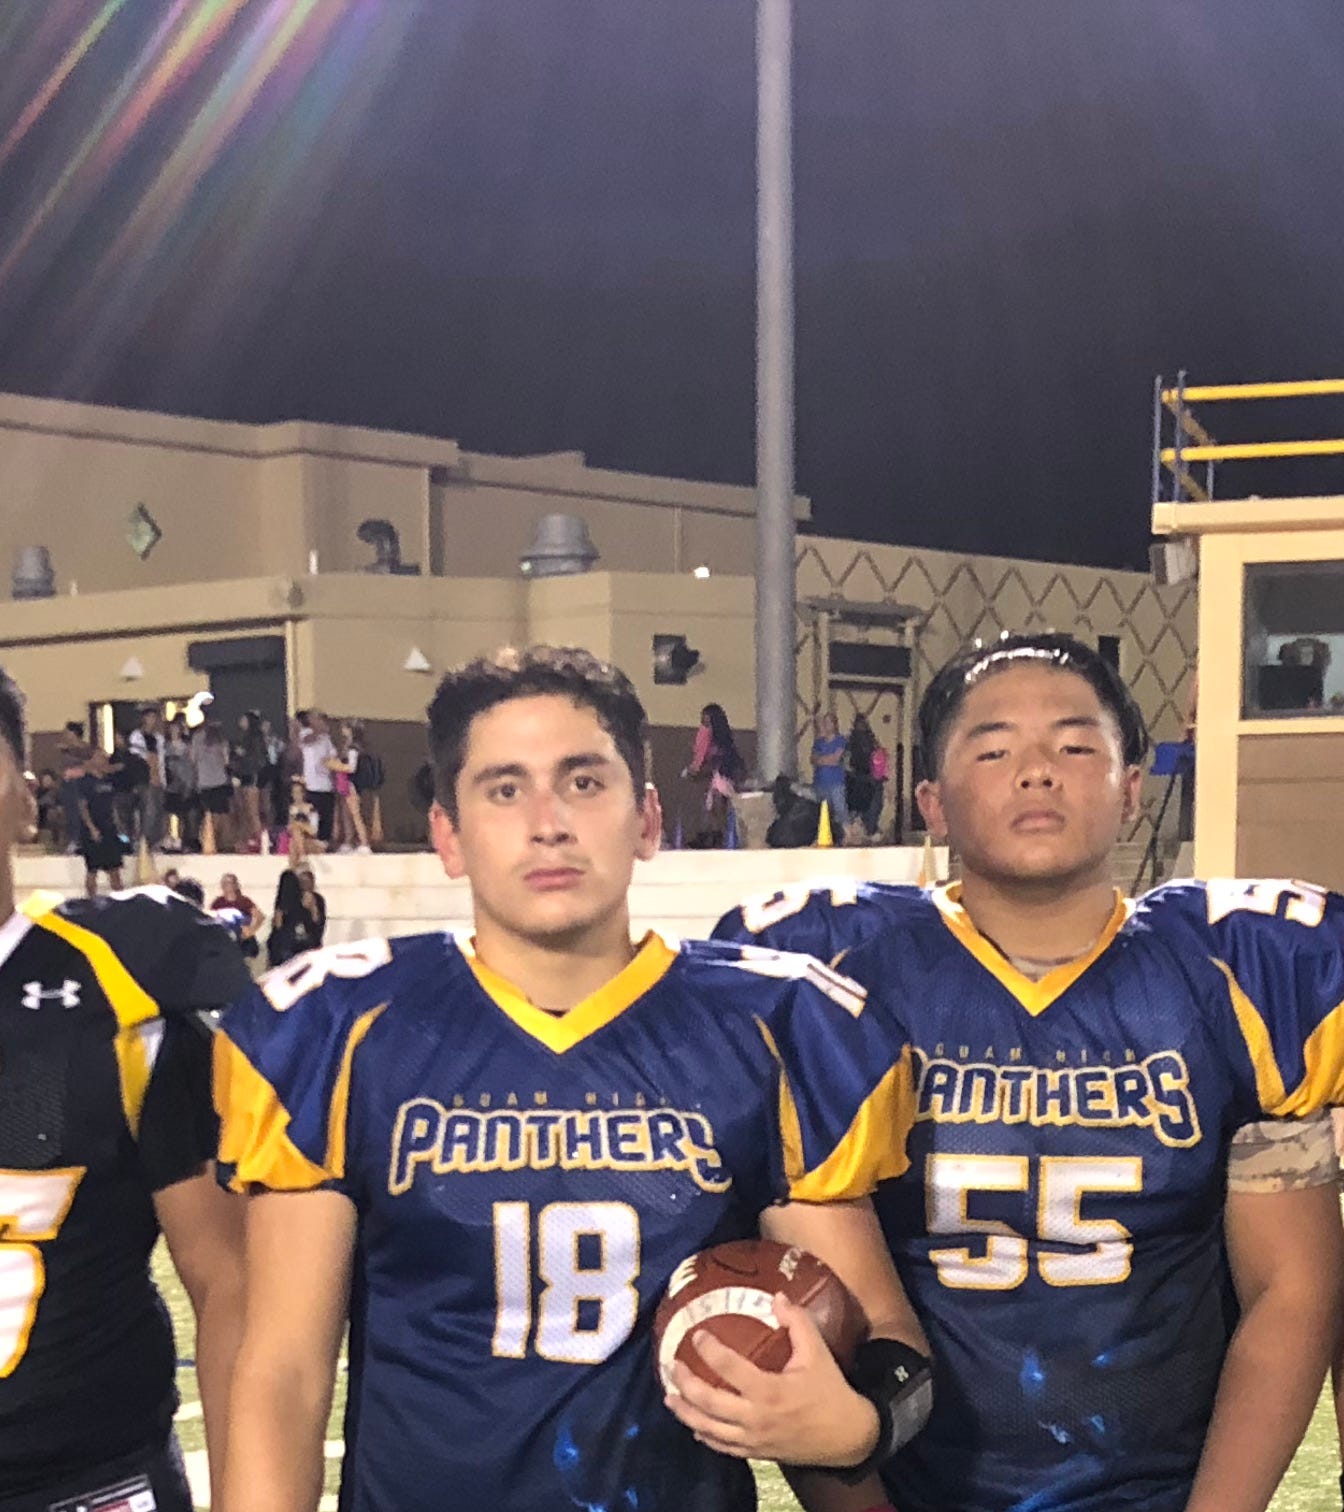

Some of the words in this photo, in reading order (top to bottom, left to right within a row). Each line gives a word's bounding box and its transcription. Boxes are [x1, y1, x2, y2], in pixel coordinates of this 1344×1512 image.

[388, 1097, 733, 1196] PANTHERS
[907, 1048, 1203, 1148] ANTHERS
[923, 1152, 1144, 1291] 55
[491, 1199, 641, 1366] 18
